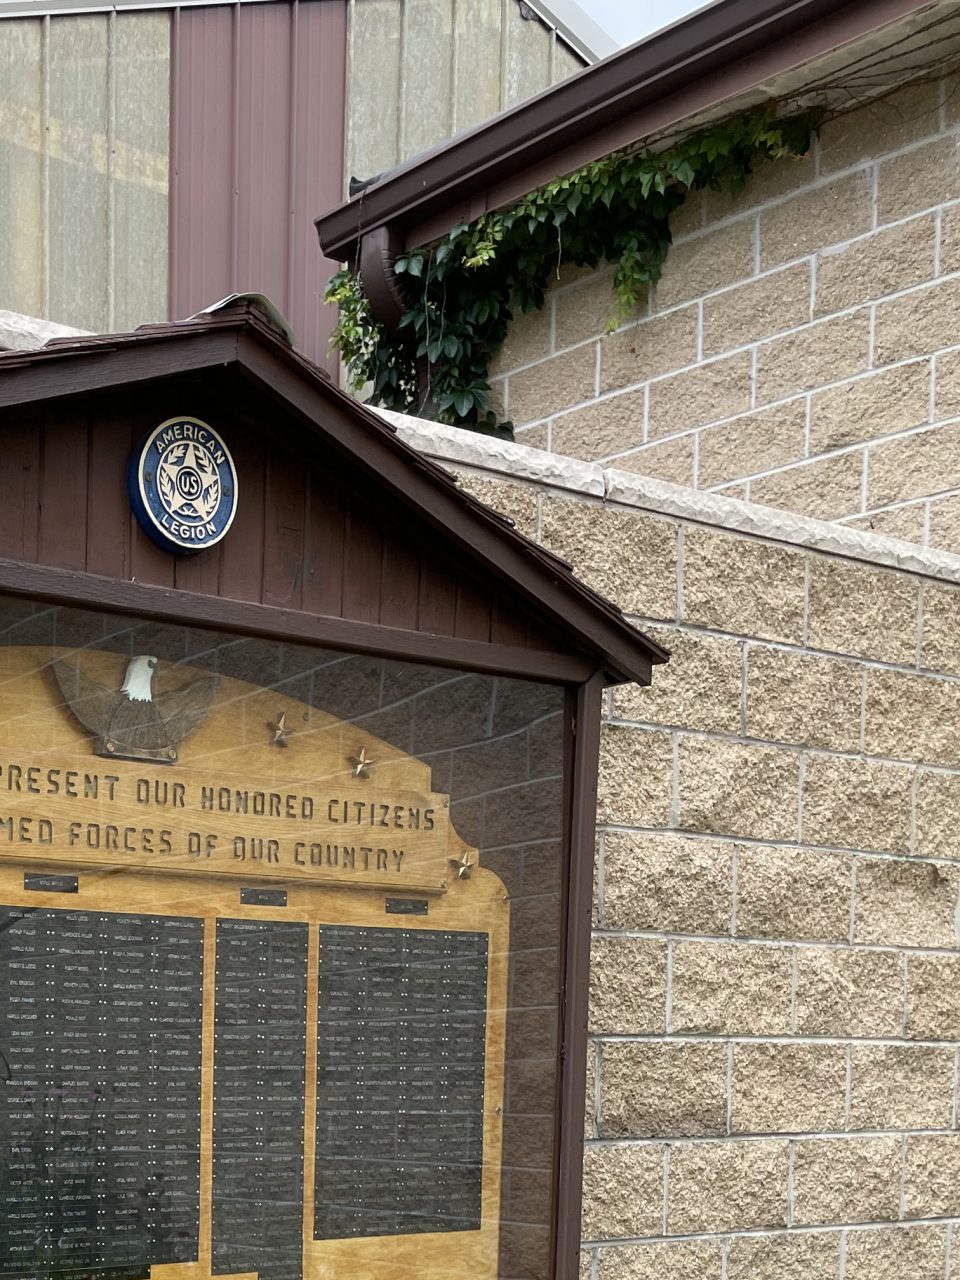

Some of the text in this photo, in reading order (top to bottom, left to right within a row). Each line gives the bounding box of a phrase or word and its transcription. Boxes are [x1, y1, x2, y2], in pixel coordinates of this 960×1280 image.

[156, 424, 225, 466] AMERICAN
[181, 475, 198, 494] US
[161, 514, 217, 539] LEGION
[137, 778, 186, 808] OUR
[201, 786, 314, 821] HONORED
[327, 799, 435, 831] CITIZENS
[68, 822, 172, 855] FORCES
[188, 831, 218, 859] OF
[233, 836, 280, 864] OUR
[294, 842, 406, 873] COUNTRY
